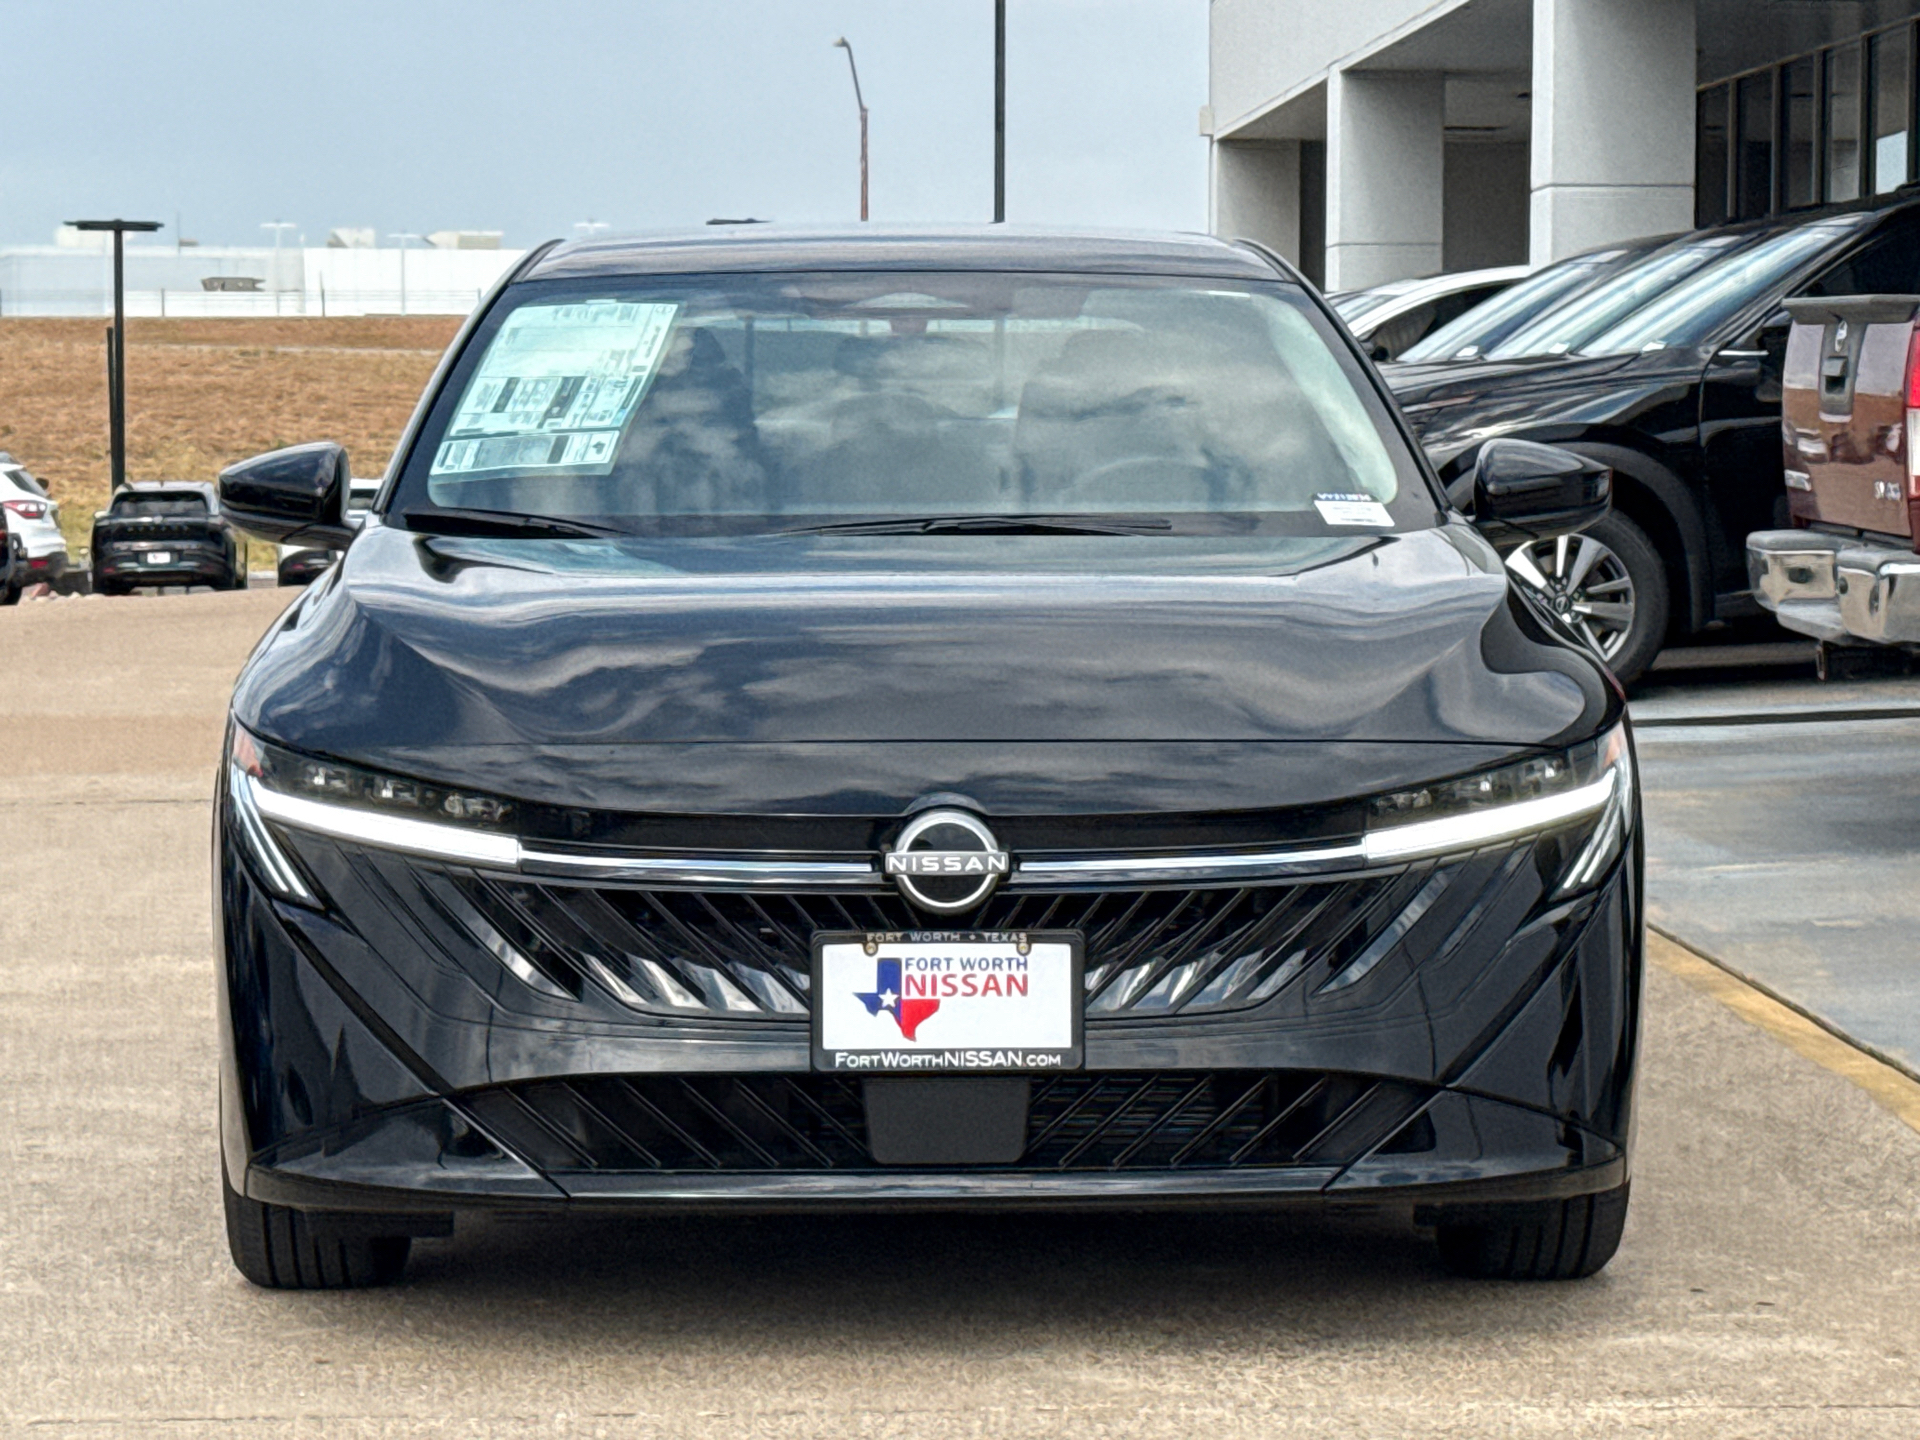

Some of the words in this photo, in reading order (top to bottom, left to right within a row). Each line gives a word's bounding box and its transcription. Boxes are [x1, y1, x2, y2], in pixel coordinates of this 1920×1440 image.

[888, 856, 1005, 871] NISSAN
[867, 932, 902, 943] FORT
[911, 932, 961, 943] WORTH
[983, 932, 1027, 943] TEXAS
[905, 957, 953, 971] FORT
[960, 957, 1028, 971] WORTH
[905, 974, 1028, 997] NISSAN
